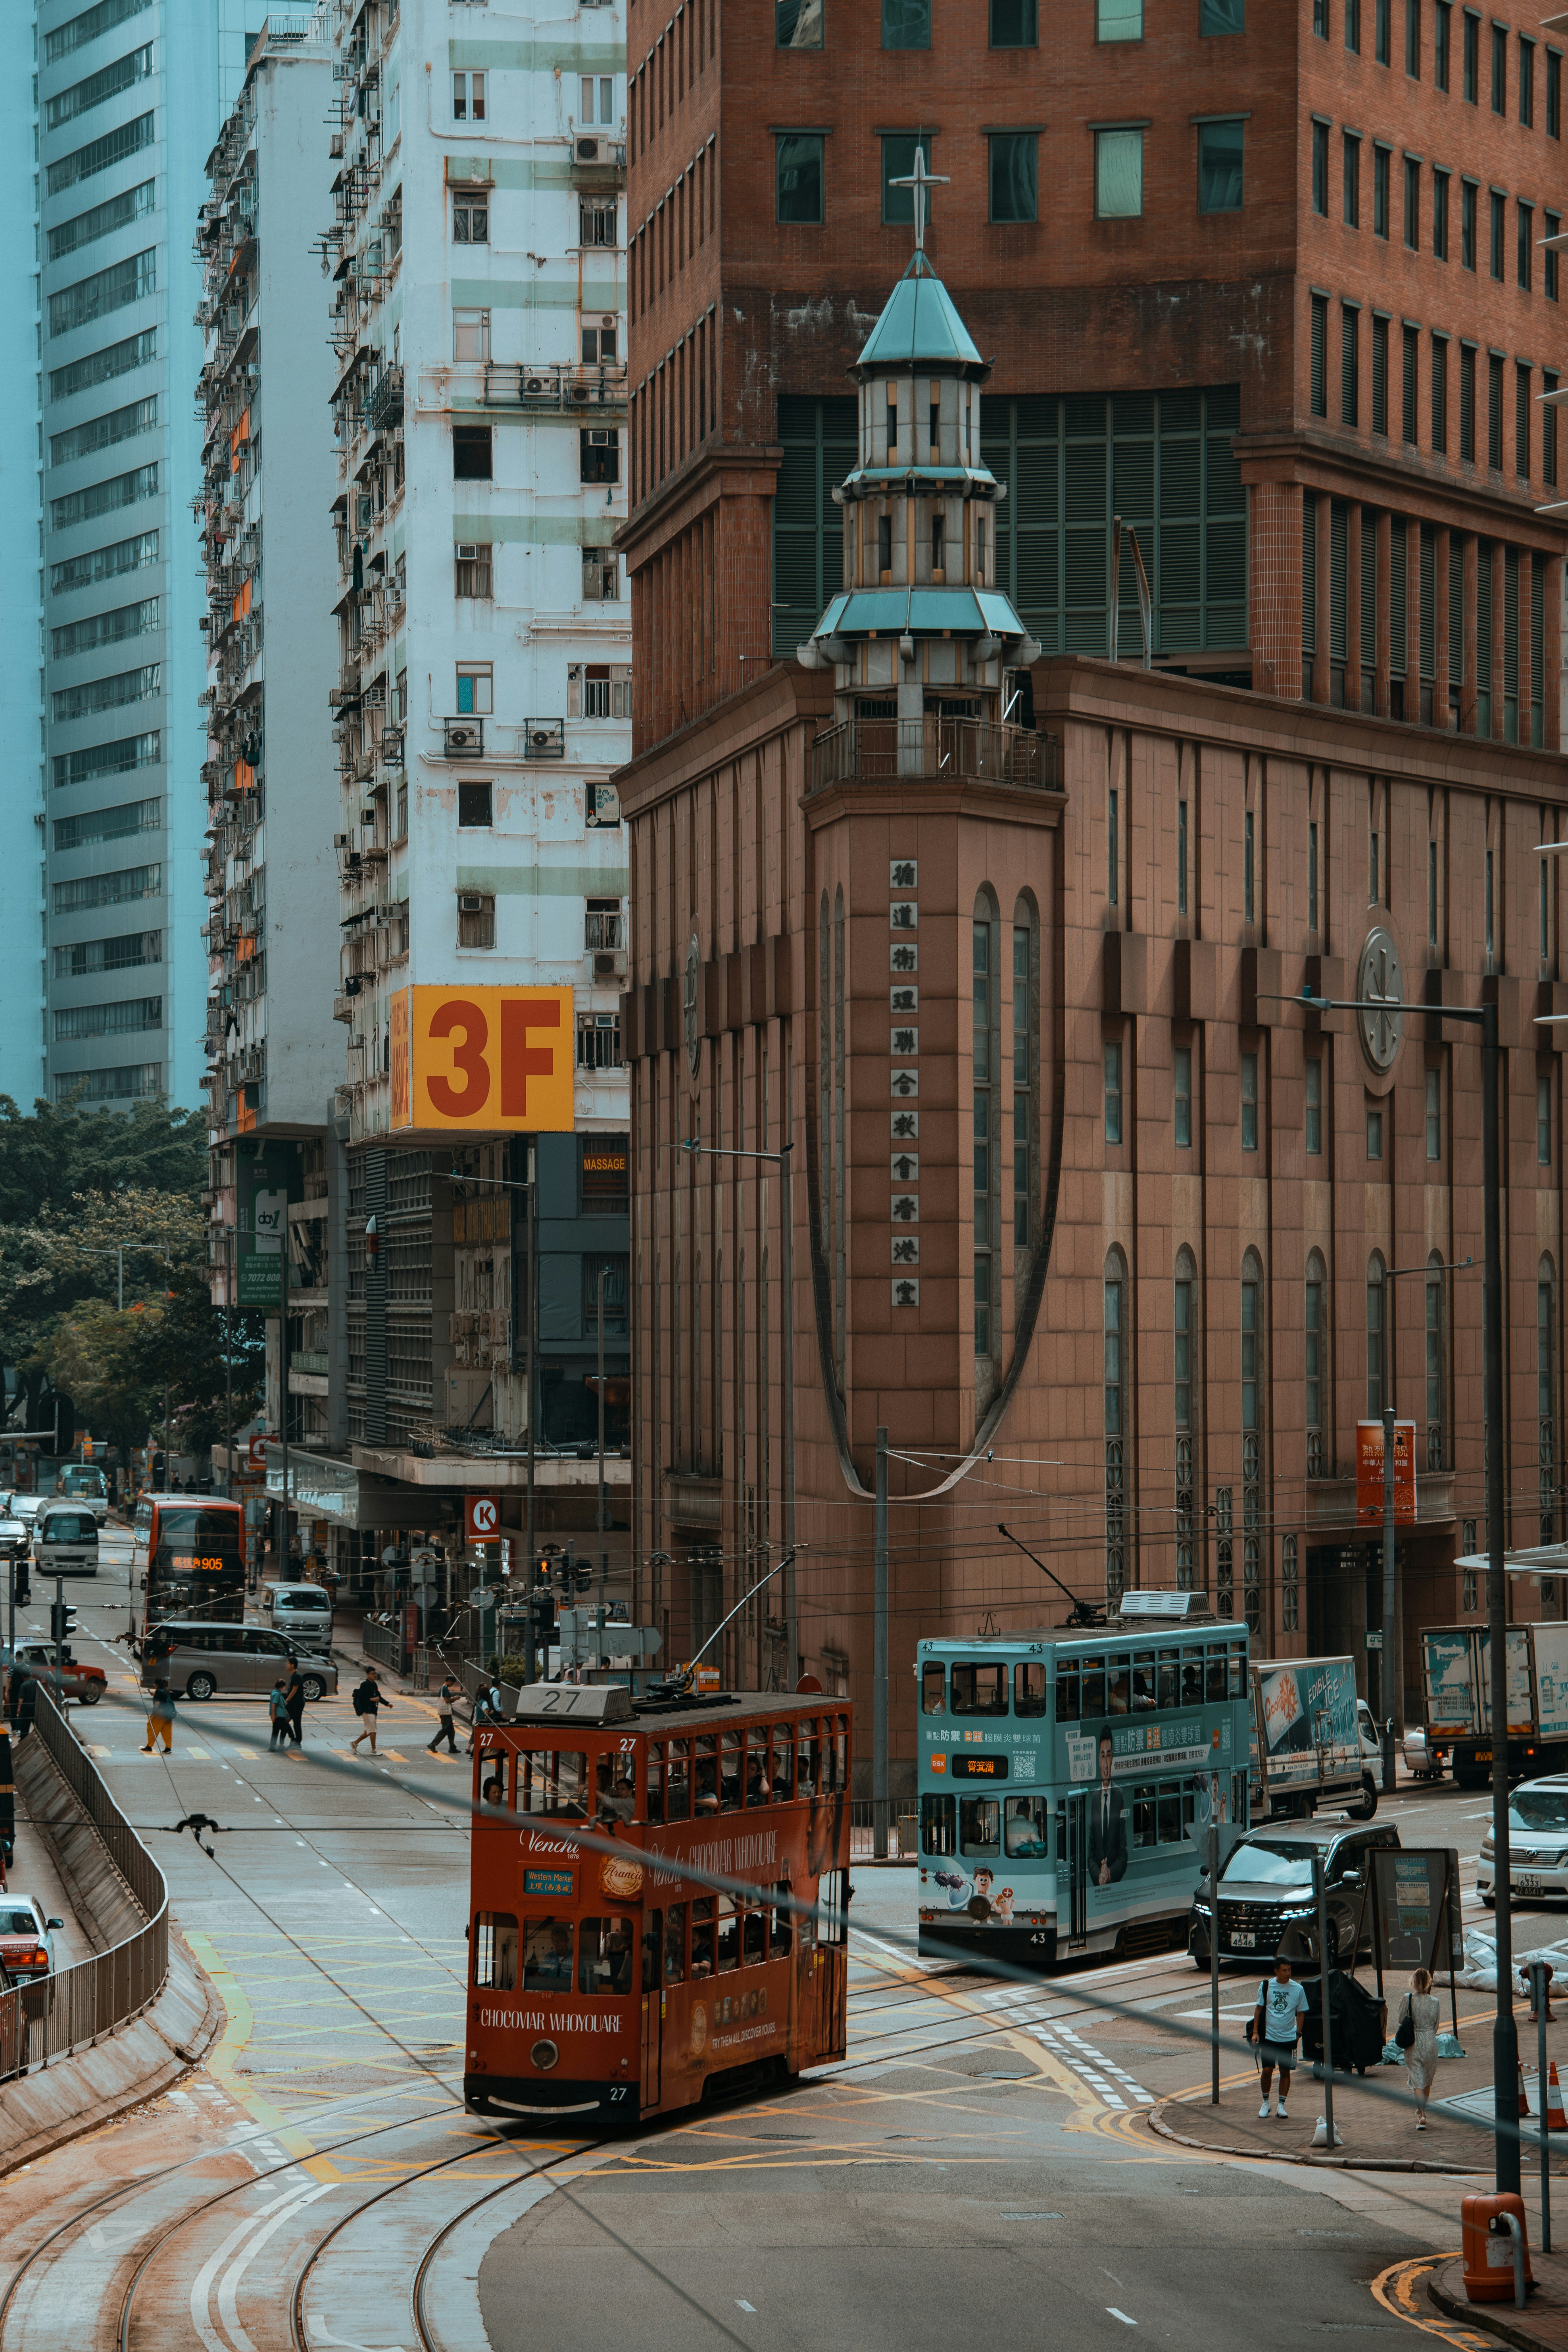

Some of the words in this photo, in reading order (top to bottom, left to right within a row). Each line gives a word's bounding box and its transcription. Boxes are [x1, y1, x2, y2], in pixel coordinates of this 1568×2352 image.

[426, 999, 560, 1118] 3F
[892, 863, 917, 1305] 循道衛理聯合教會香港堂
[584, 1159, 625, 1170] MASSAGE
[258, 1210, 281, 1229] day1
[248, 1274, 265, 1282] 7072
[202, 1558, 223, 1570] 905
[922, 1642, 933, 1651] 43
[1029, 1644, 1043, 1653] 43
[1308, 1669, 1331, 1705] EDIBLE
[1324, 1678, 1340, 1709] ICE
[542, 1691, 580, 1713] 27
[1265, 1691, 1287, 1722] Cooling
[480, 1733, 493, 1746] 27
[620, 1738, 637, 1751] 27
[967, 1760, 994, 1773] 筲箕灣
[520, 1828, 581, 1854] Venchi
[613, 1856, 638, 1866] CHOCOVIAR
[649, 1843, 684, 1888] Venchi
[529, 1872, 551, 1881] Western
[602, 1864, 644, 1880] Arancia
[1030, 1933, 1045, 1944] 43
[481, 2008, 545, 2030] CHOCOVIAR
[550, 2013, 623, 2033] WHOYOUARE
[712, 2038, 721, 2050] TRY
[721, 2035, 732, 2047] THEM
[741, 2026, 761, 2042] DISCOVER
[610, 2087, 627, 2101] 27
